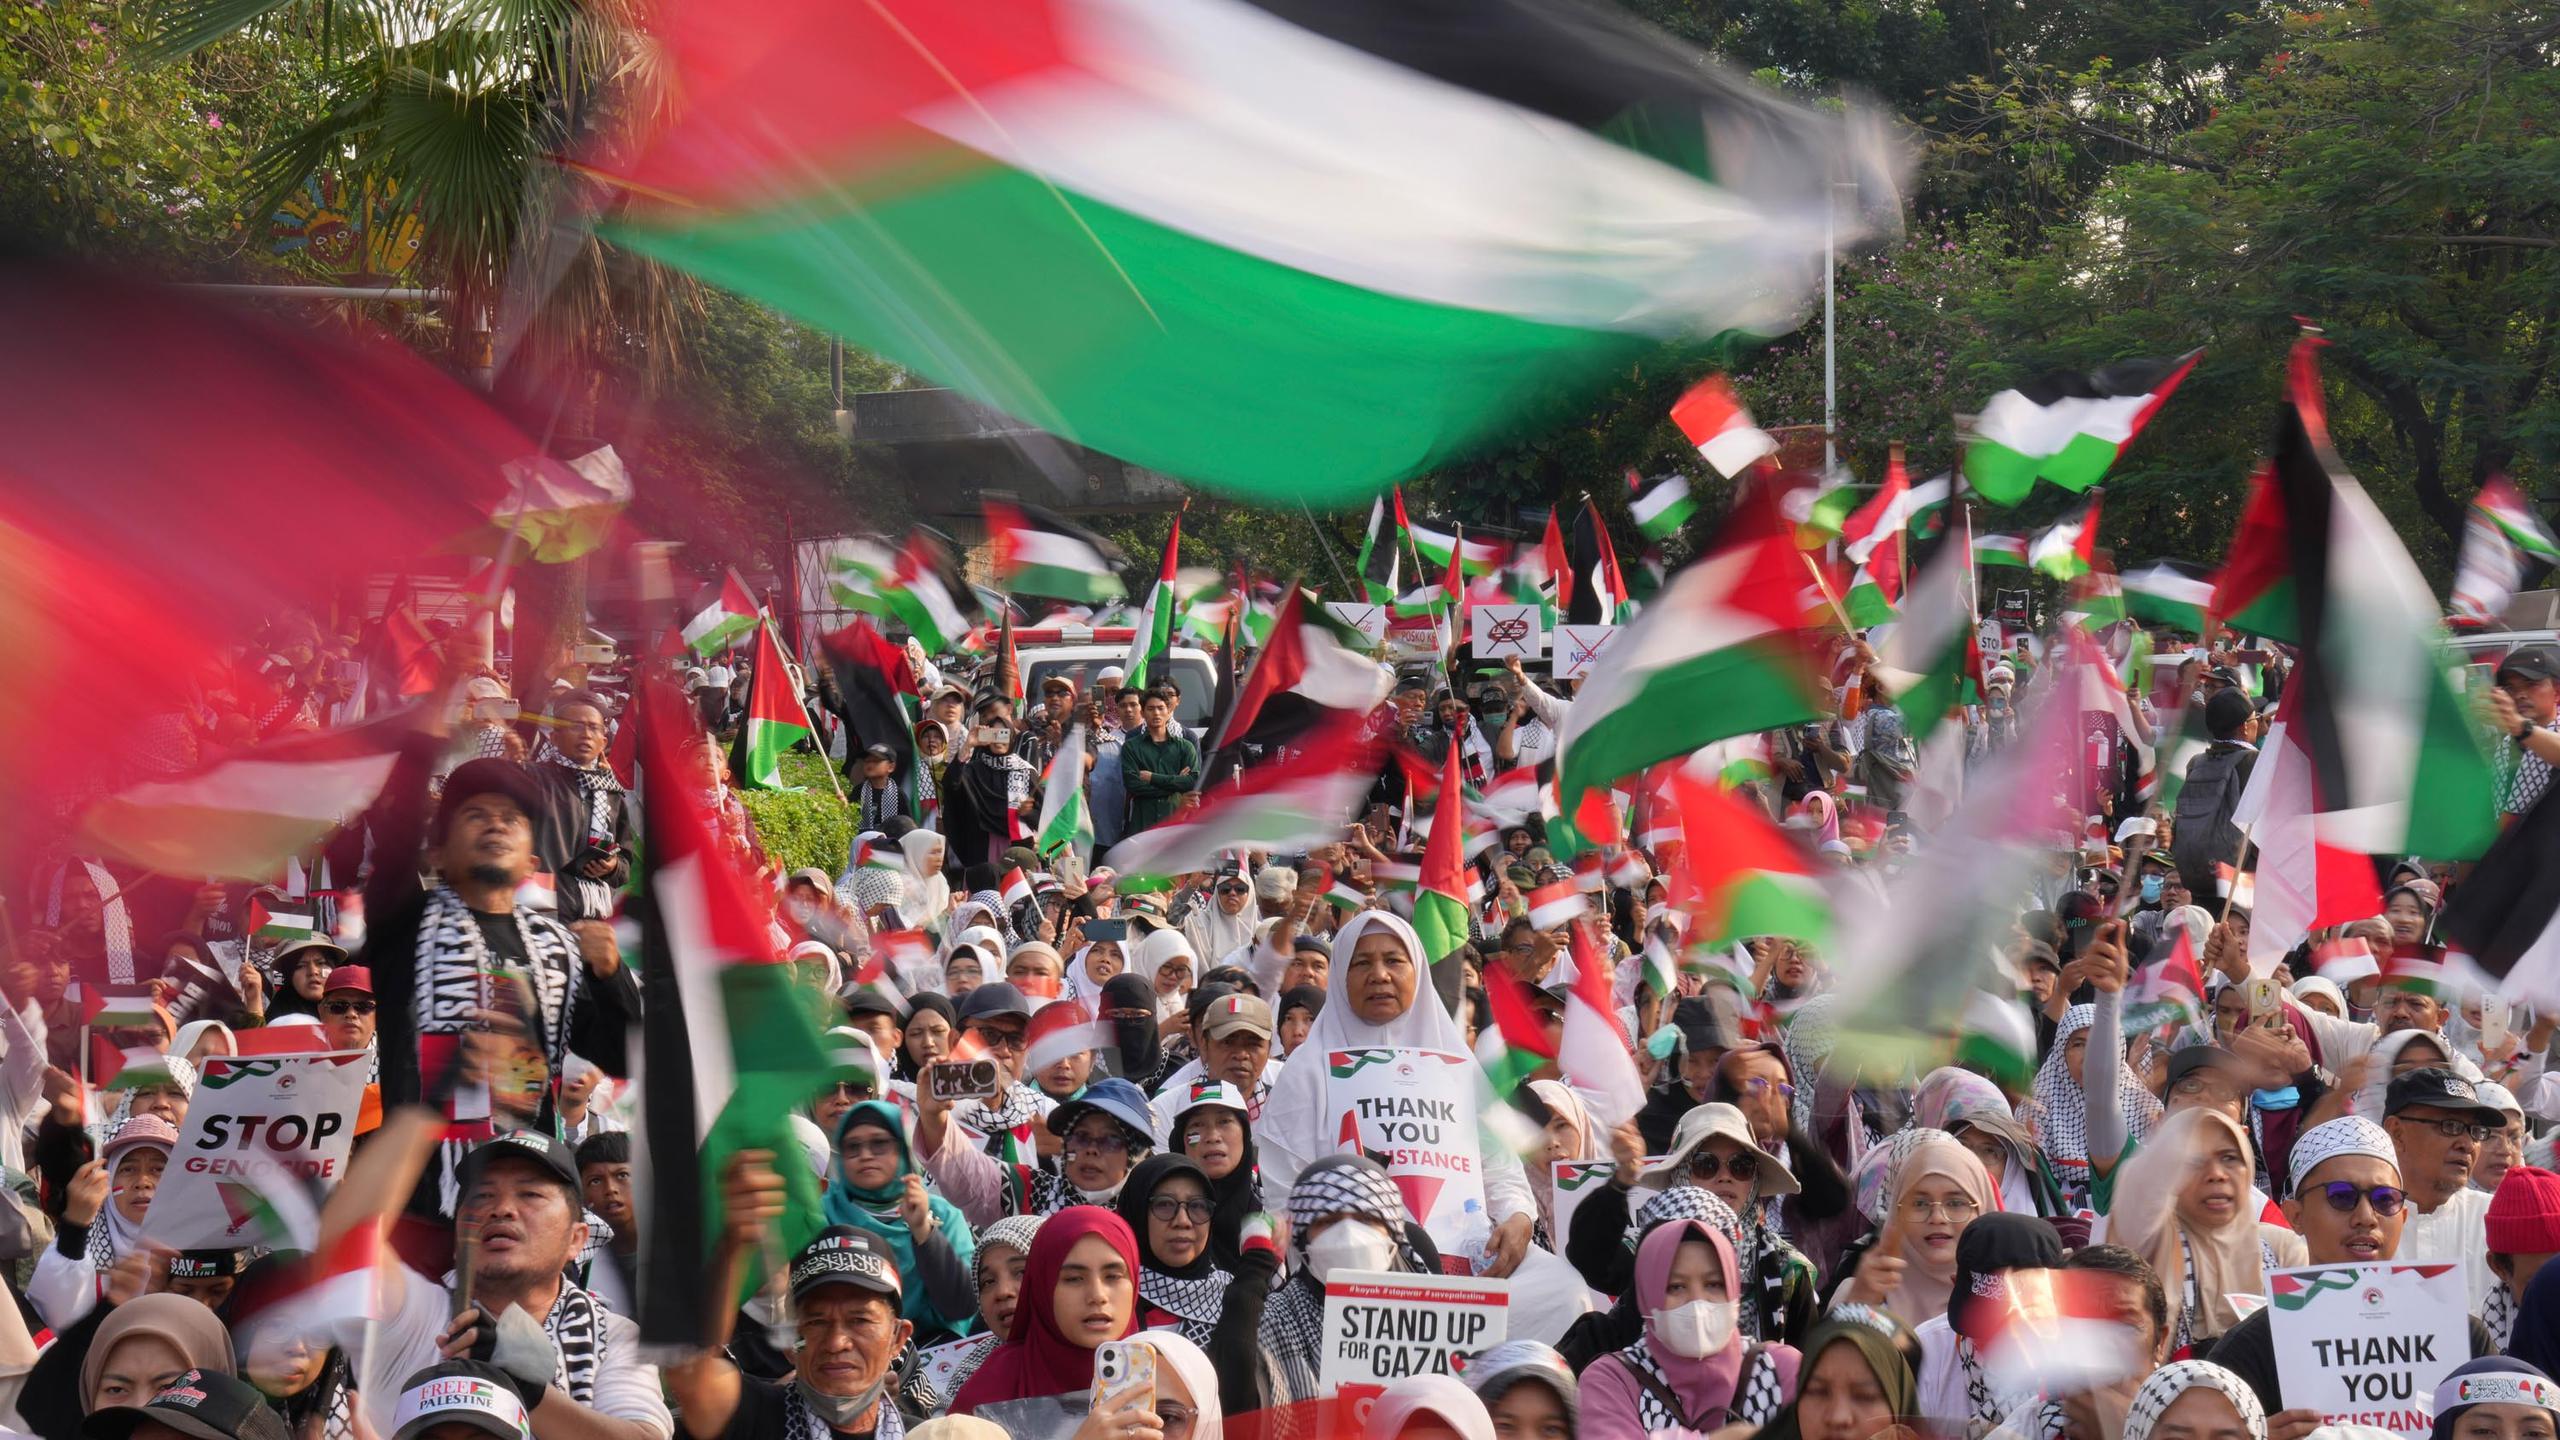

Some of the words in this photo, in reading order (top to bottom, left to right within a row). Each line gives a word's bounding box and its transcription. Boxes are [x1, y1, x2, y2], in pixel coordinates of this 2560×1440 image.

[1570, 651, 1607, 662] Nestl
[434, 945, 478, 1018] SAVE
[1357, 1097, 1456, 1123] THANK
[196, 1112, 342, 1152] STOP
[1378, 1122, 1440, 1145] YOU
[185, 1157, 335, 1179] GENOIDE
[1379, 1149, 1471, 1173] ISTANCE
[170, 1269, 216, 1277] PALESTINE
[1382, 1287, 1422, 1299] #stopwar
[1424, 1289, 1486, 1302] #savepalestine
[1341, 1305, 1437, 1342] STAND
[1447, 1311, 1486, 1345] UP
[1339, 1341, 1369, 1360] FOR
[1372, 1345, 1450, 1378] GAZA
[2312, 1334, 2437, 1367] THANK
[420, 1380, 469, 1400] FREE
[2342, 1371, 2413, 1402] YOU
[419, 1394, 494, 1410] PALESTINE
[2321, 1410, 2434, 1432] ESISTAN
